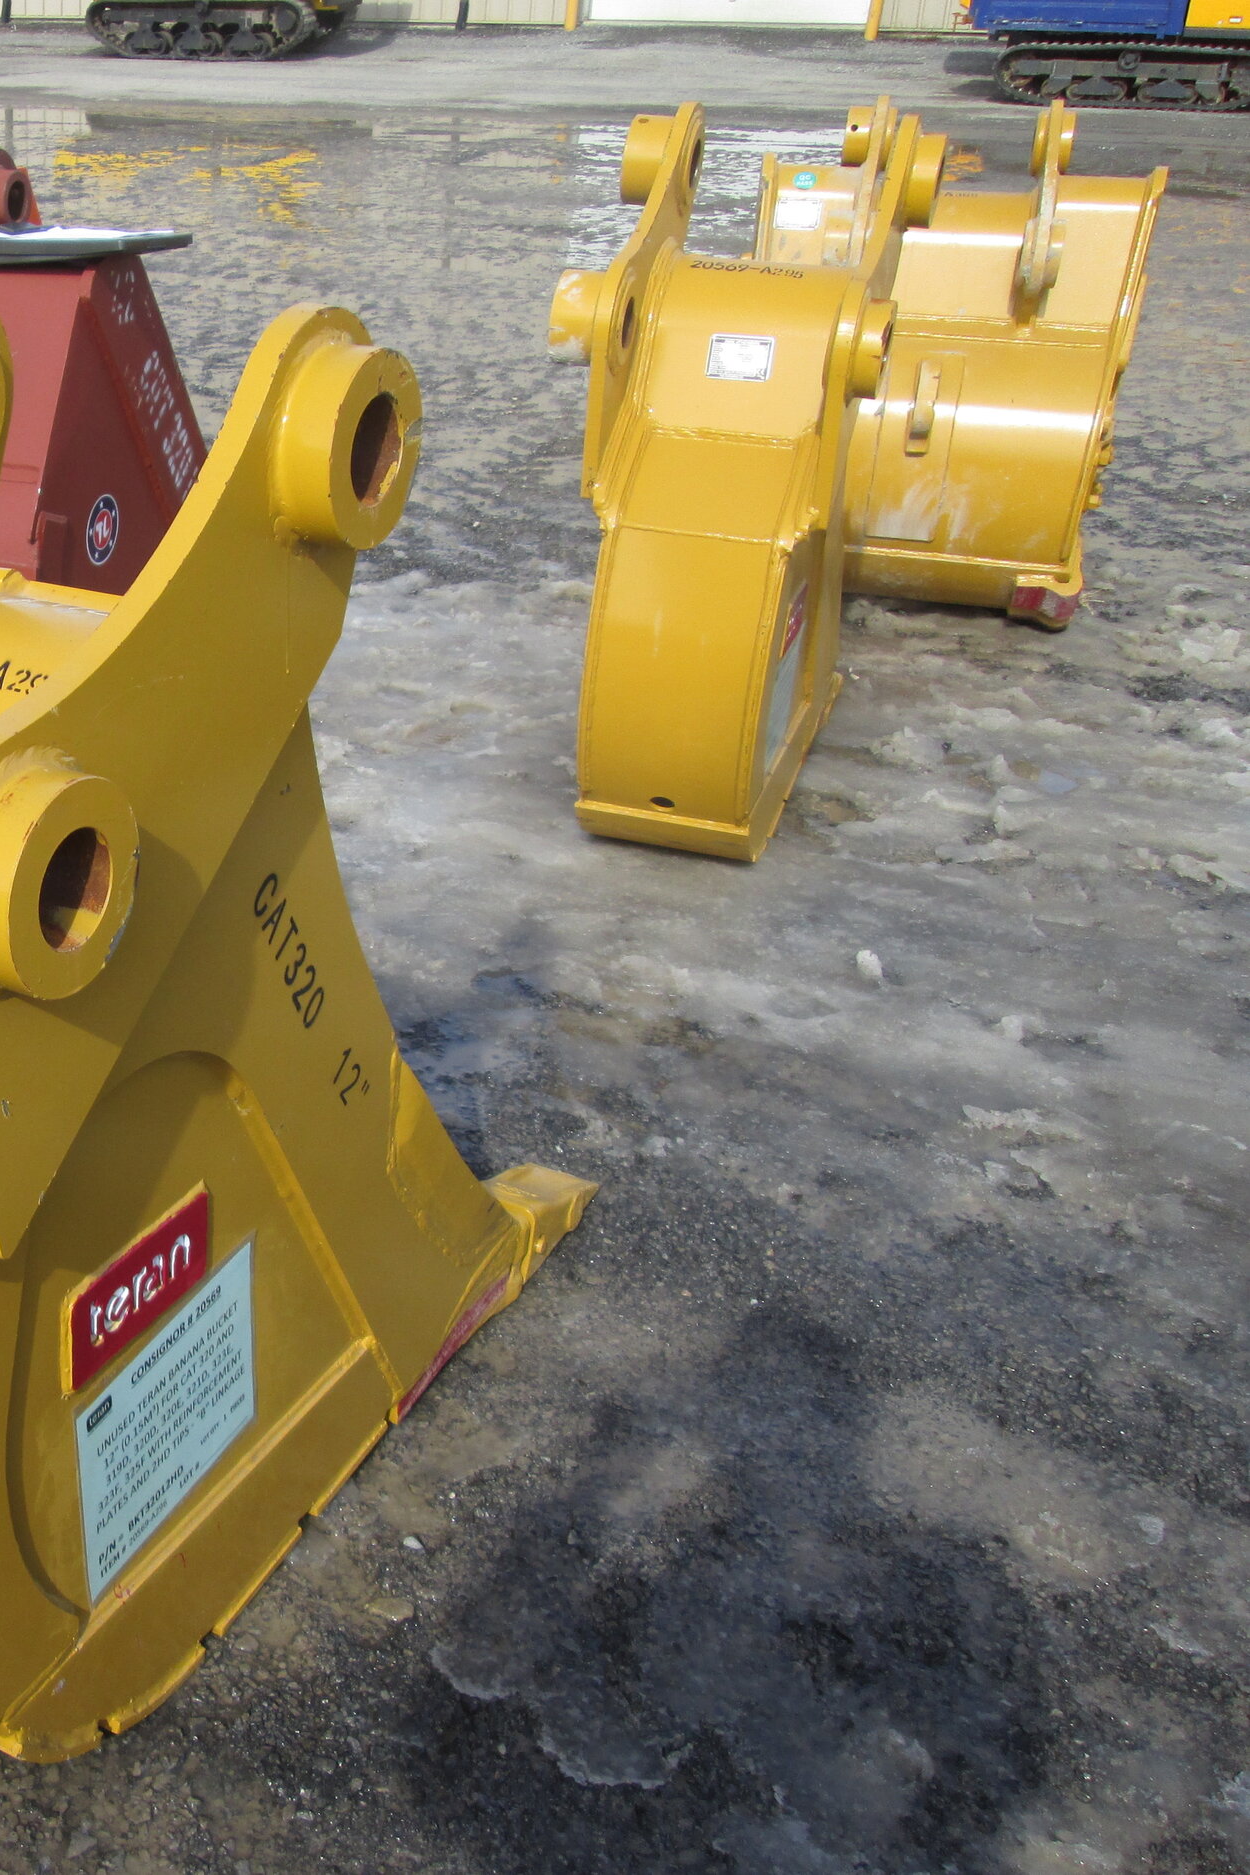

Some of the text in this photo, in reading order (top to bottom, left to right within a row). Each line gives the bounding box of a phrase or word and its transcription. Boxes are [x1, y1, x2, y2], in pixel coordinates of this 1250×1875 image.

[254, 873, 370, 1106] CAT320 12"
[89, 1233, 191, 1347] teran
[131, 1322, 185, 1384] CONSIGNOR
[195, 1285, 221, 1318] 20569
[88, 1400, 111, 1428] teran
[96, 1301, 236, 1456] UNUSED TERAN BANANA BUCKET
[147, 1427, 171, 1457] WITH
[173, 1351, 240, 1430] REINFORCEMENT
[161, 1382, 178, 1407] FOR
[180, 1363, 196, 1386] CAT
[199, 1344, 214, 1367] 320
[215, 1323, 234, 1348] AND
[96, 1493, 128, 1534] PLATES
[130, 1469, 149, 1496] AND
[152, 1447, 170, 1472] 2HD
[172, 1425, 189, 1449] TIPS
[211, 1366, 243, 1406] LINKAGE
[179, 1468, 192, 1488] LOT
[98, 1539, 116, 1565] P/N
[128, 1465, 183, 1531] BKT32012HD
[100, 1551, 120, 1577] ITEM
